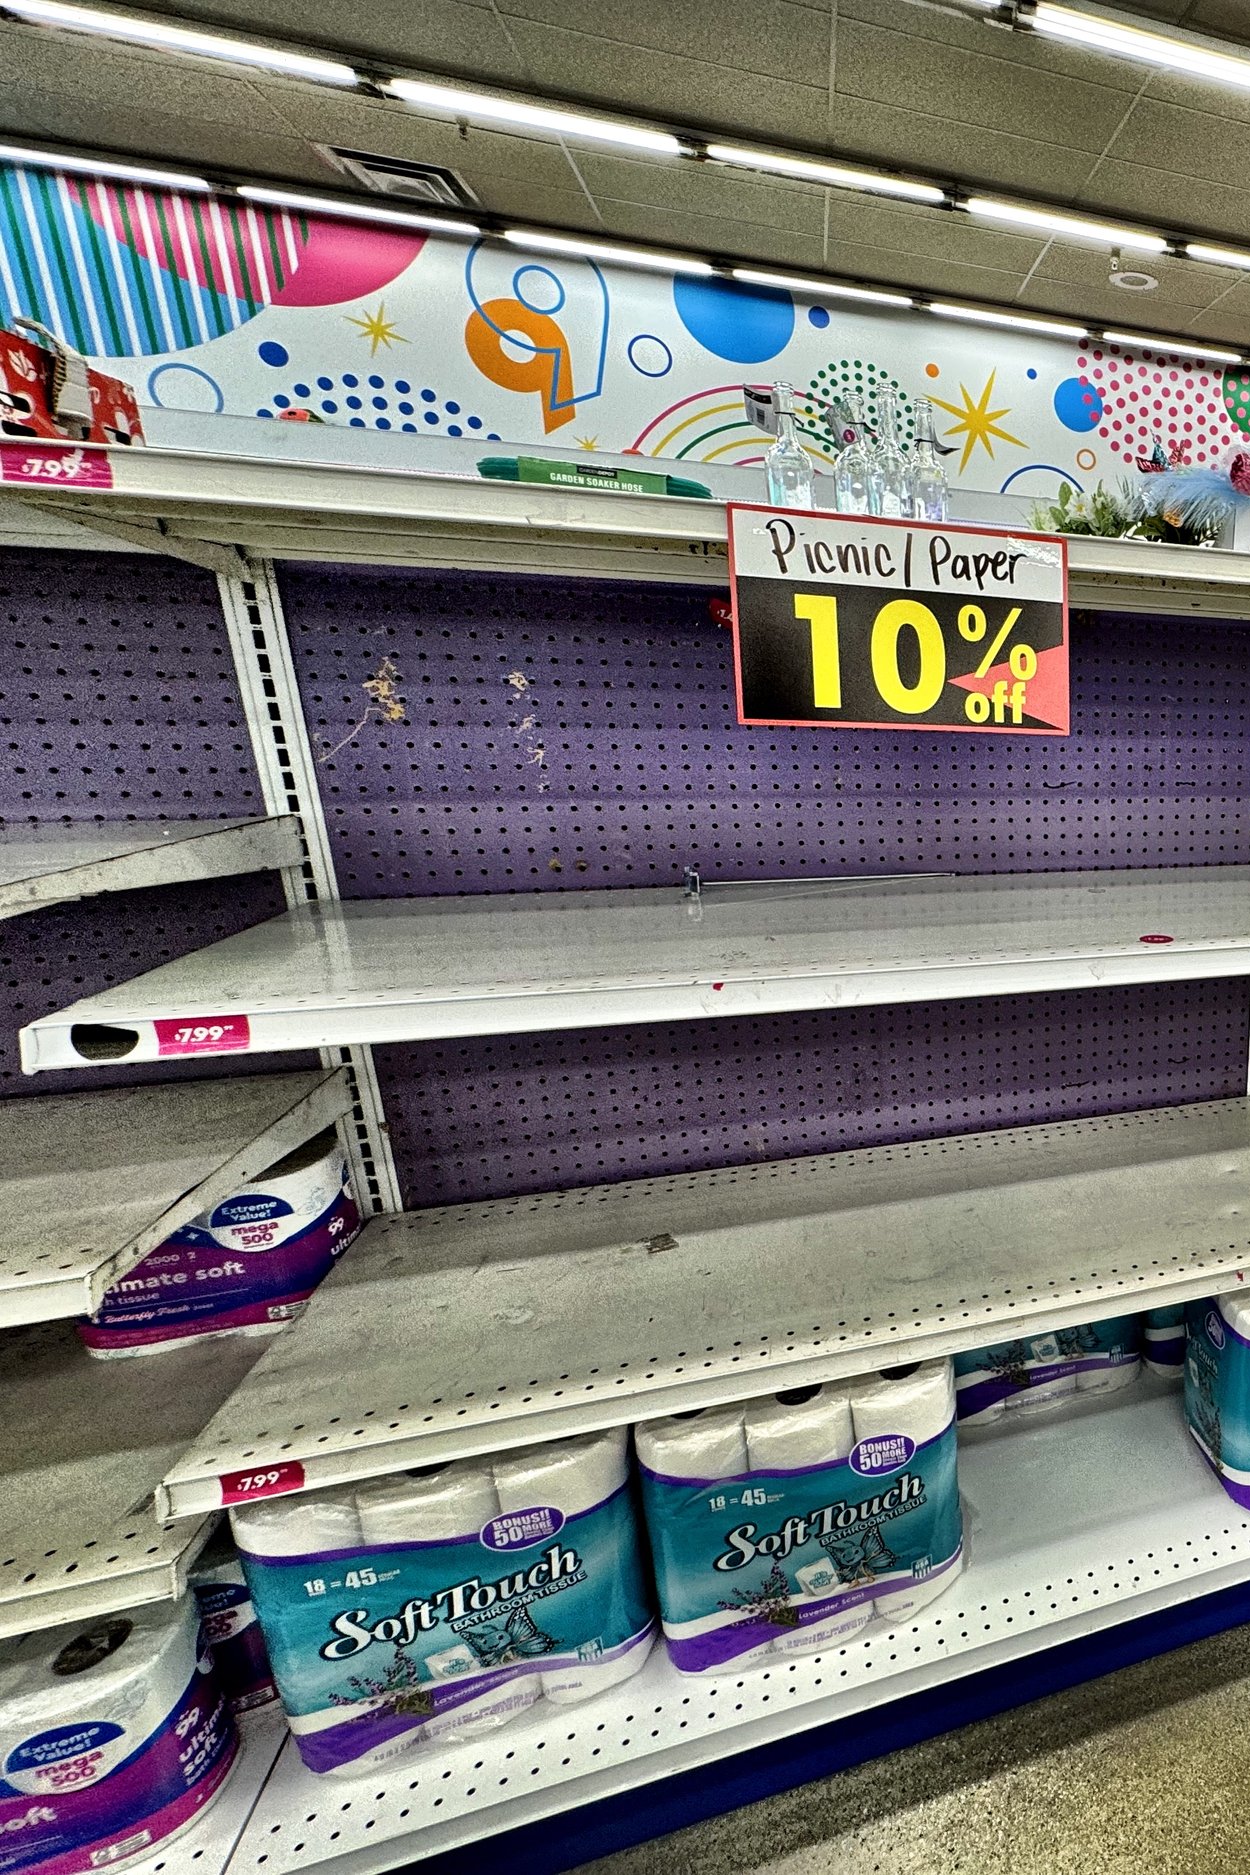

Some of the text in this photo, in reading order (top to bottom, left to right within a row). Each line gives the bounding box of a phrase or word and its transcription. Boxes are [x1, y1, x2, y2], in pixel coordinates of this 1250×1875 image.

[550, 472, 644, 493] GARDEN SOAKER HOSE
[794, 593, 1038, 714] 10%
[965, 680, 1027, 724] off
[221, 1201, 277, 1217] Extreme
[230, 1210, 272, 1222] Value!
[231, 1221, 279, 1237] mega
[242, 1233, 274, 1245] 500
[195, 1261, 247, 1281] soft
[859, 1437, 905, 1455] BONUS!!
[859, 1452, 883, 1471] 50
[882, 1446, 907, 1459] MORE
[708, 1495, 726, 1509] 18
[741, 1488, 767, 1506] 45
[492, 1508, 550, 1530] BONUS!!
[717, 1472, 923, 1569] Soft Touch
[820, 1495, 927, 1547] BATHROOM TISSUE
[494, 1526, 523, 1547] 50
[522, 1519, 552, 1532] MORE
[304, 1579, 326, 1593] 18
[345, 1567, 378, 1589] 45
[323, 1545, 580, 1659] Soft Touch
[452, 1570, 587, 1632] BATHROOM TISSUE
[799, 1603, 839, 1619] Lavender
[19, 1727, 100, 1758] Extreme
[33, 1739, 92, 1762] Value!
[183, 1732, 218, 1777] soft
[35, 1750, 104, 1778] mega
[51, 1766, 96, 1786] 500
[0, 1806, 58, 1835] oft
